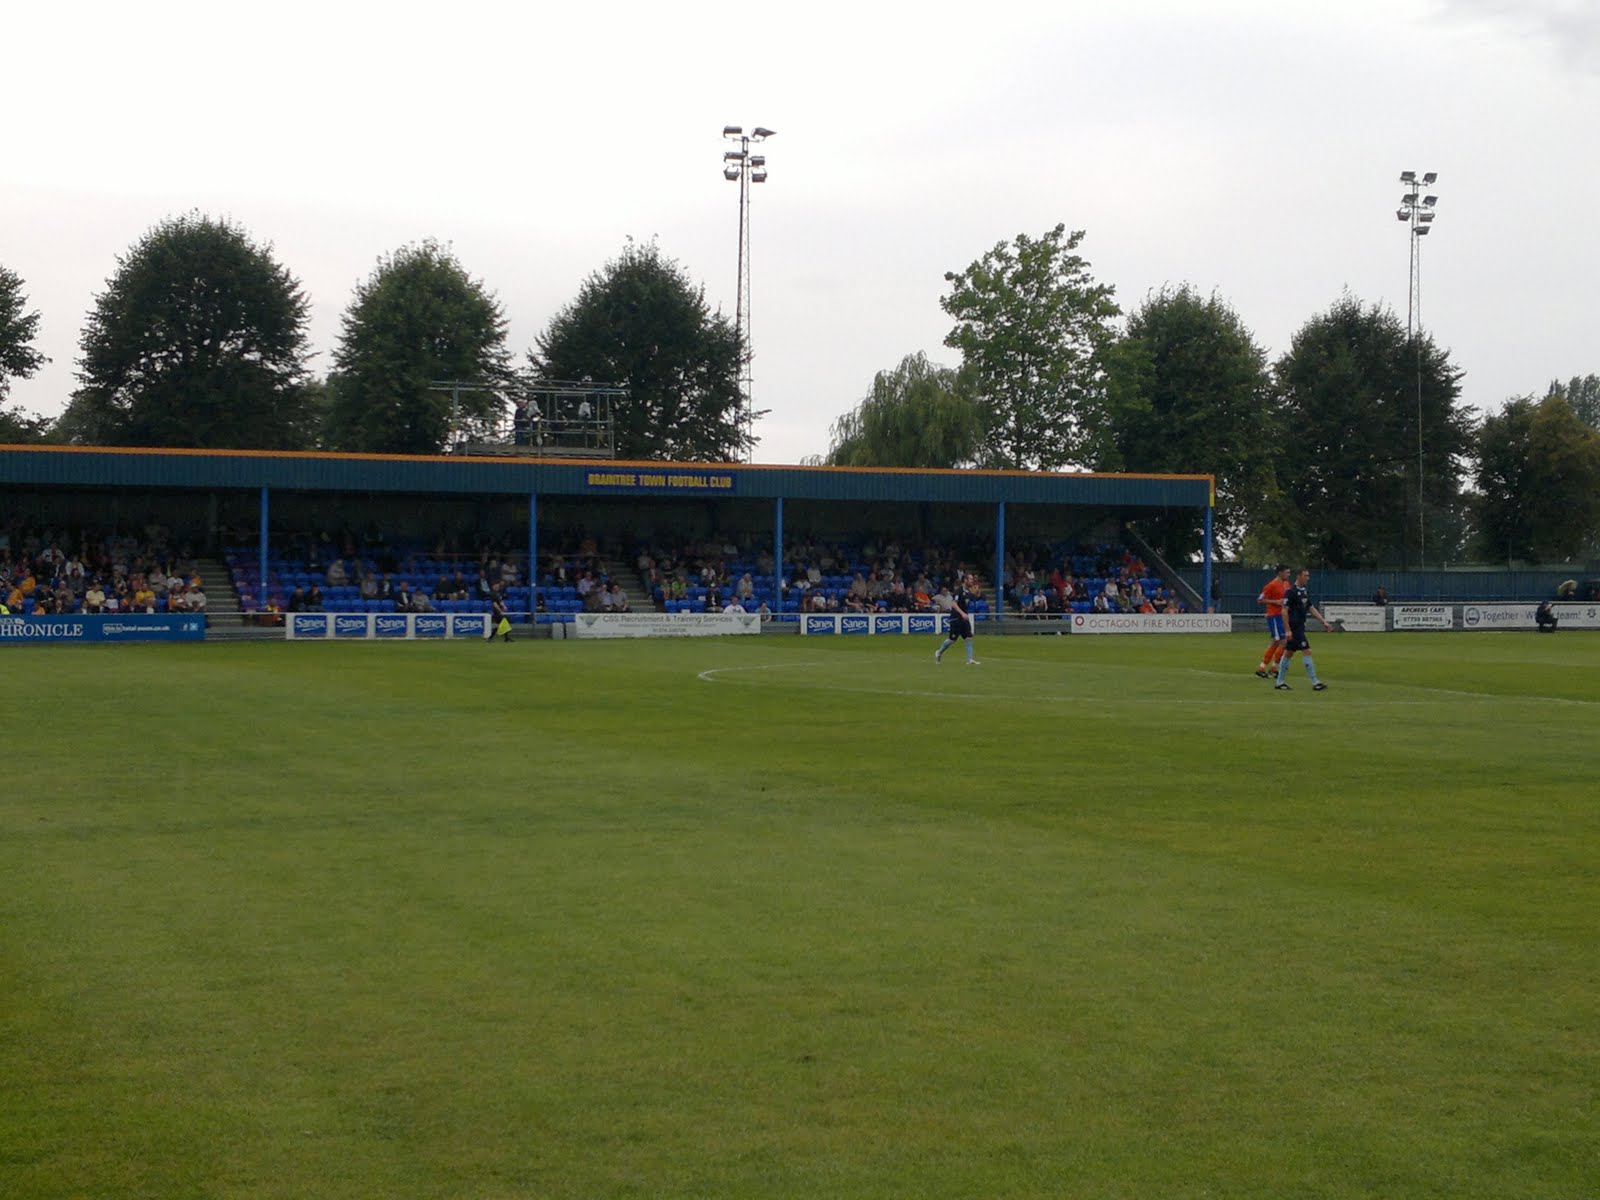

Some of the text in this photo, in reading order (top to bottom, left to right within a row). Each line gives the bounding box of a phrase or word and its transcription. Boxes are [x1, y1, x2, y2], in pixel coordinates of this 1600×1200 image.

[639, 474, 666, 487] TOWN
[668, 475, 708, 488] FOOTBALL
[710, 476, 732, 488] CLUB
[602, 615, 733, 624] CSS Recruitment & Training Services
[1482, 611, 1519, 622] Together
[295, 617, 326, 628] Sanex
[336, 617, 366, 628] Sanex
[376, 617, 406, 628] Sanex
[416, 618, 446, 628] Sanex
[454, 618, 483, 629] Sanex
[808, 618, 834, 629] Sanex
[842, 618, 868, 629] Sanex
[876, 618, 901, 629] Sanex
[909, 618, 934, 629] Sanex
[1089, 618, 1230, 629] OCTAGON FIRE PROTECTION
